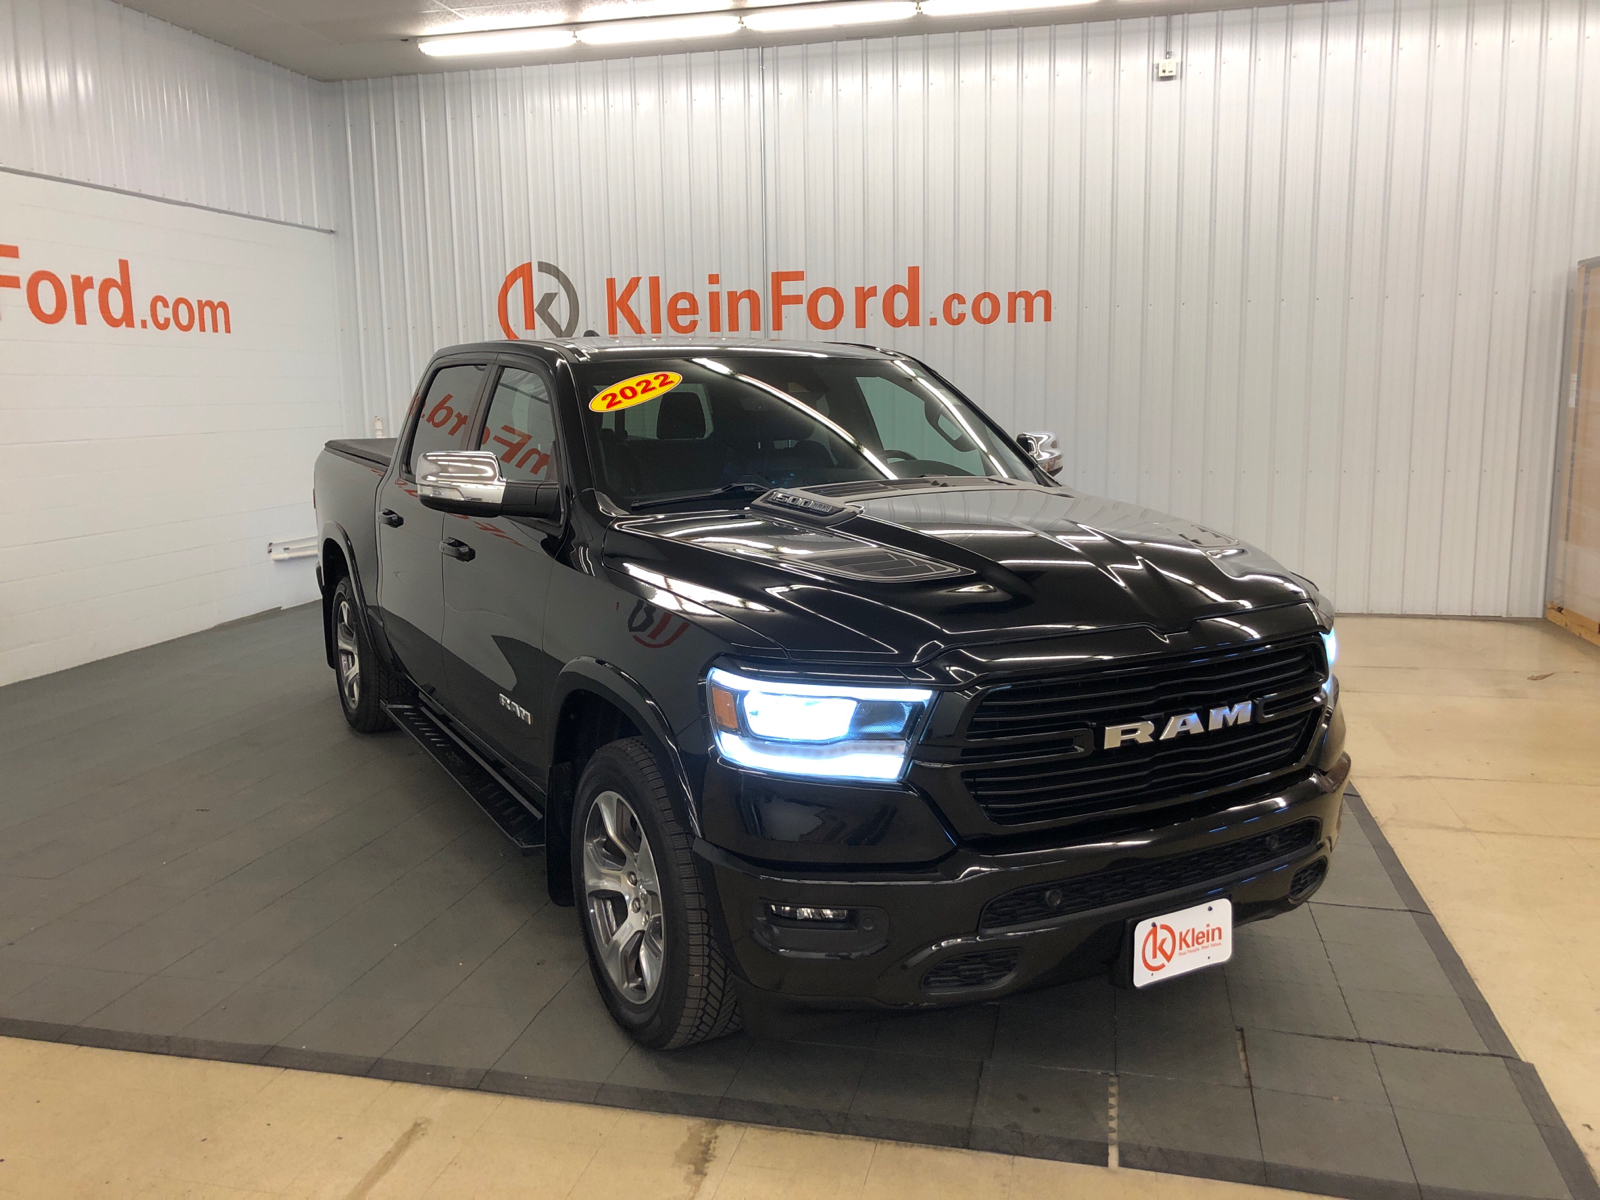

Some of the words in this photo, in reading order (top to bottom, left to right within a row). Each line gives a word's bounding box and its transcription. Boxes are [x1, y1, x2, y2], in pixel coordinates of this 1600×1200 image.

[605, 265, 1052, 336] KleinFord.com
[602, 373, 674, 409] 2022
[499, 693, 532, 726] RAM
[1103, 700, 1252, 750] RAM
[1178, 923, 1223, 951] Klein
